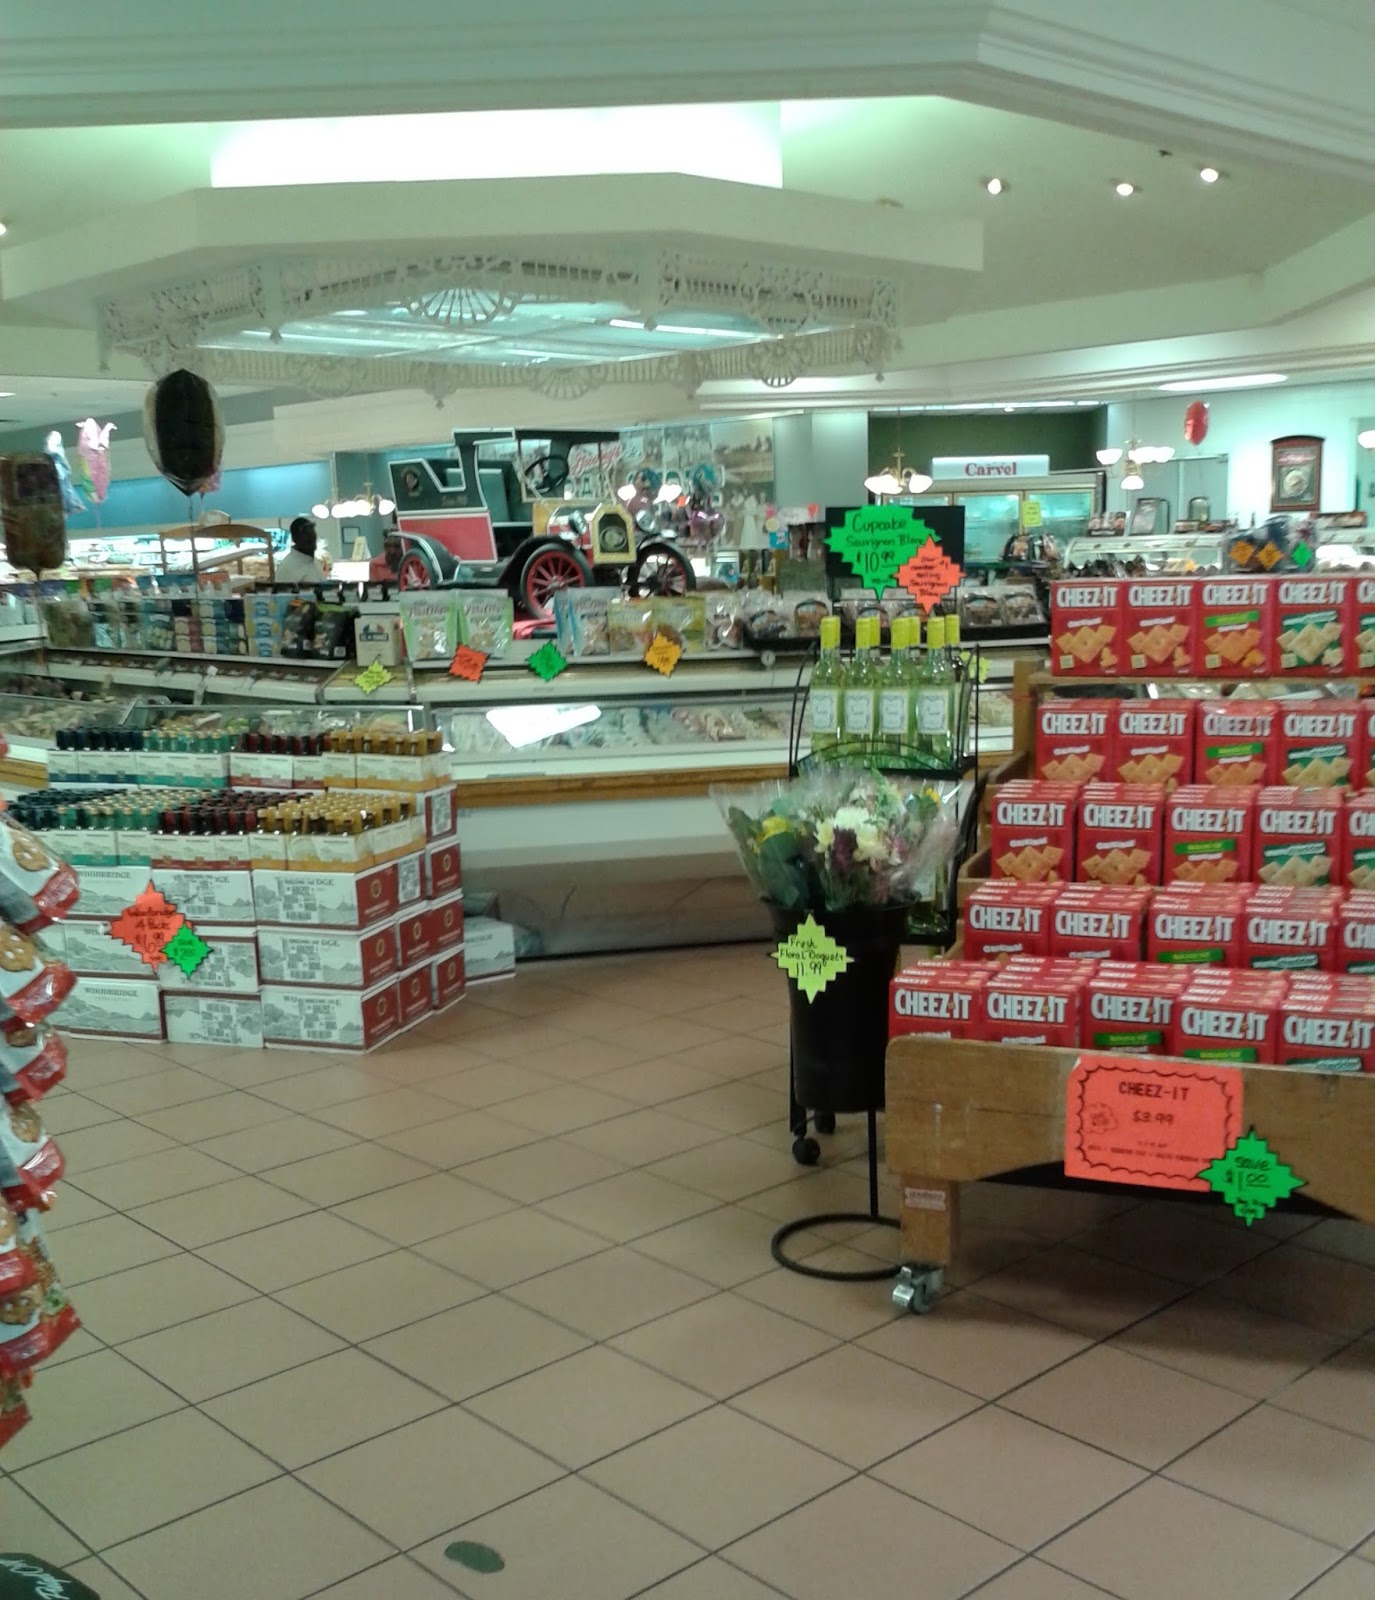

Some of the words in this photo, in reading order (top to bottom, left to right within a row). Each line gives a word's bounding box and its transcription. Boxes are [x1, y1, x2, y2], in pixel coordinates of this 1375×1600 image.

[964, 461, 1018, 477] Carvel
[852, 514, 907, 534] Cupcake
[790, 937, 817, 949] Fresh
[779, 949, 805, 960] Floral
[1118, 1081, 1191, 1101] CHEEZ-IT
